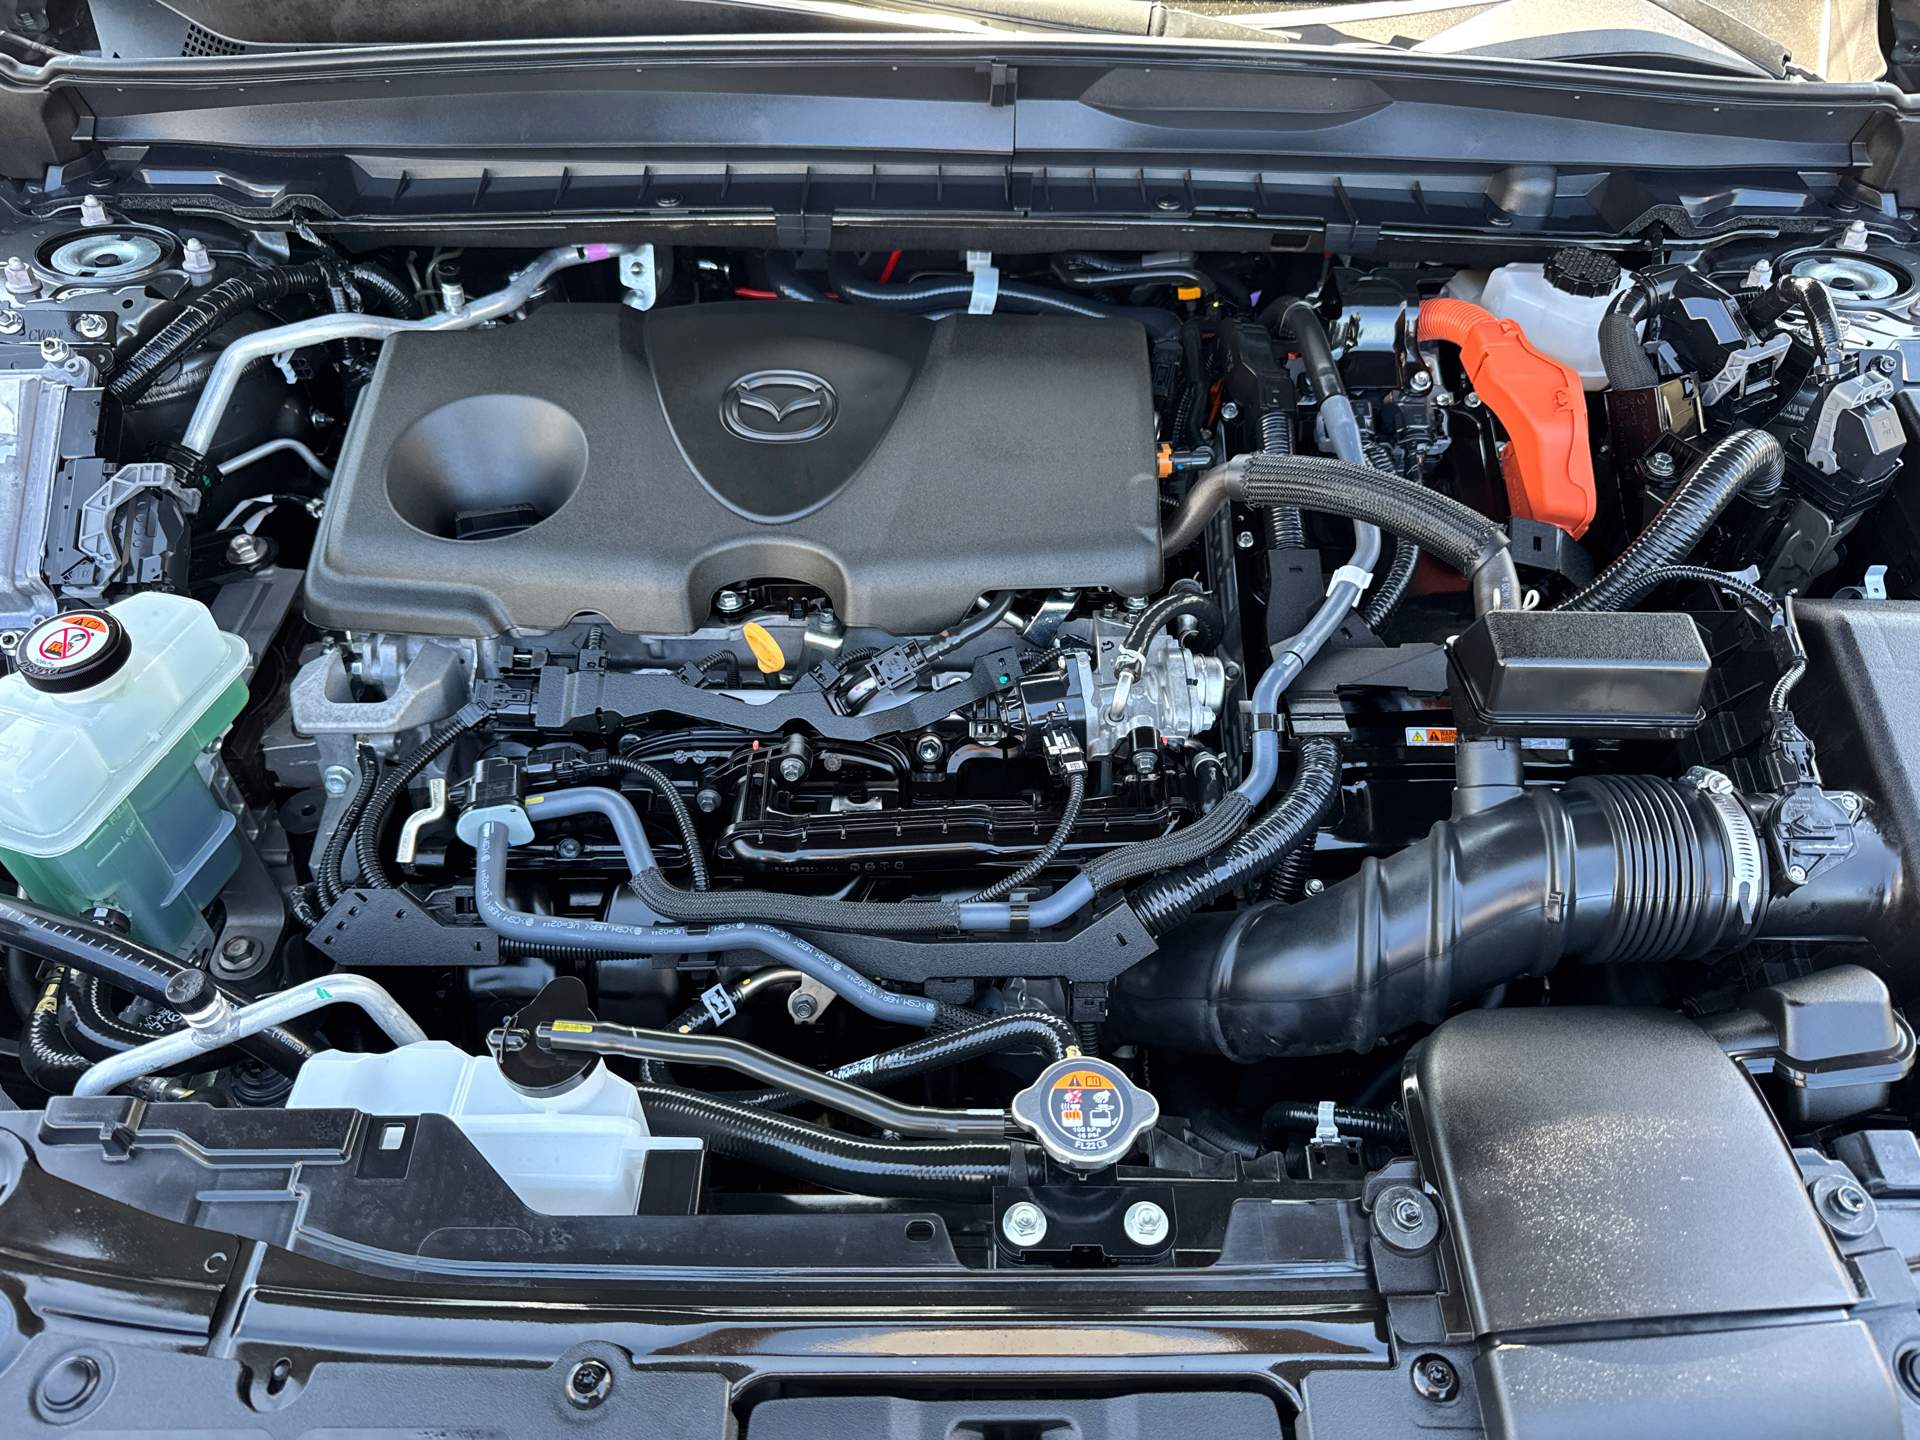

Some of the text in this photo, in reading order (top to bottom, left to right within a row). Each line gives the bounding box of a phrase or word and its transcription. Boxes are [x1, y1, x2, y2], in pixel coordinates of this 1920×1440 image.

[108, 803, 130, 826] FULL
[120, 819, 139, 844] LOW
[271, 1029, 305, 1055] (16mm)
[1074, 1140, 1097, 1150] FL22
